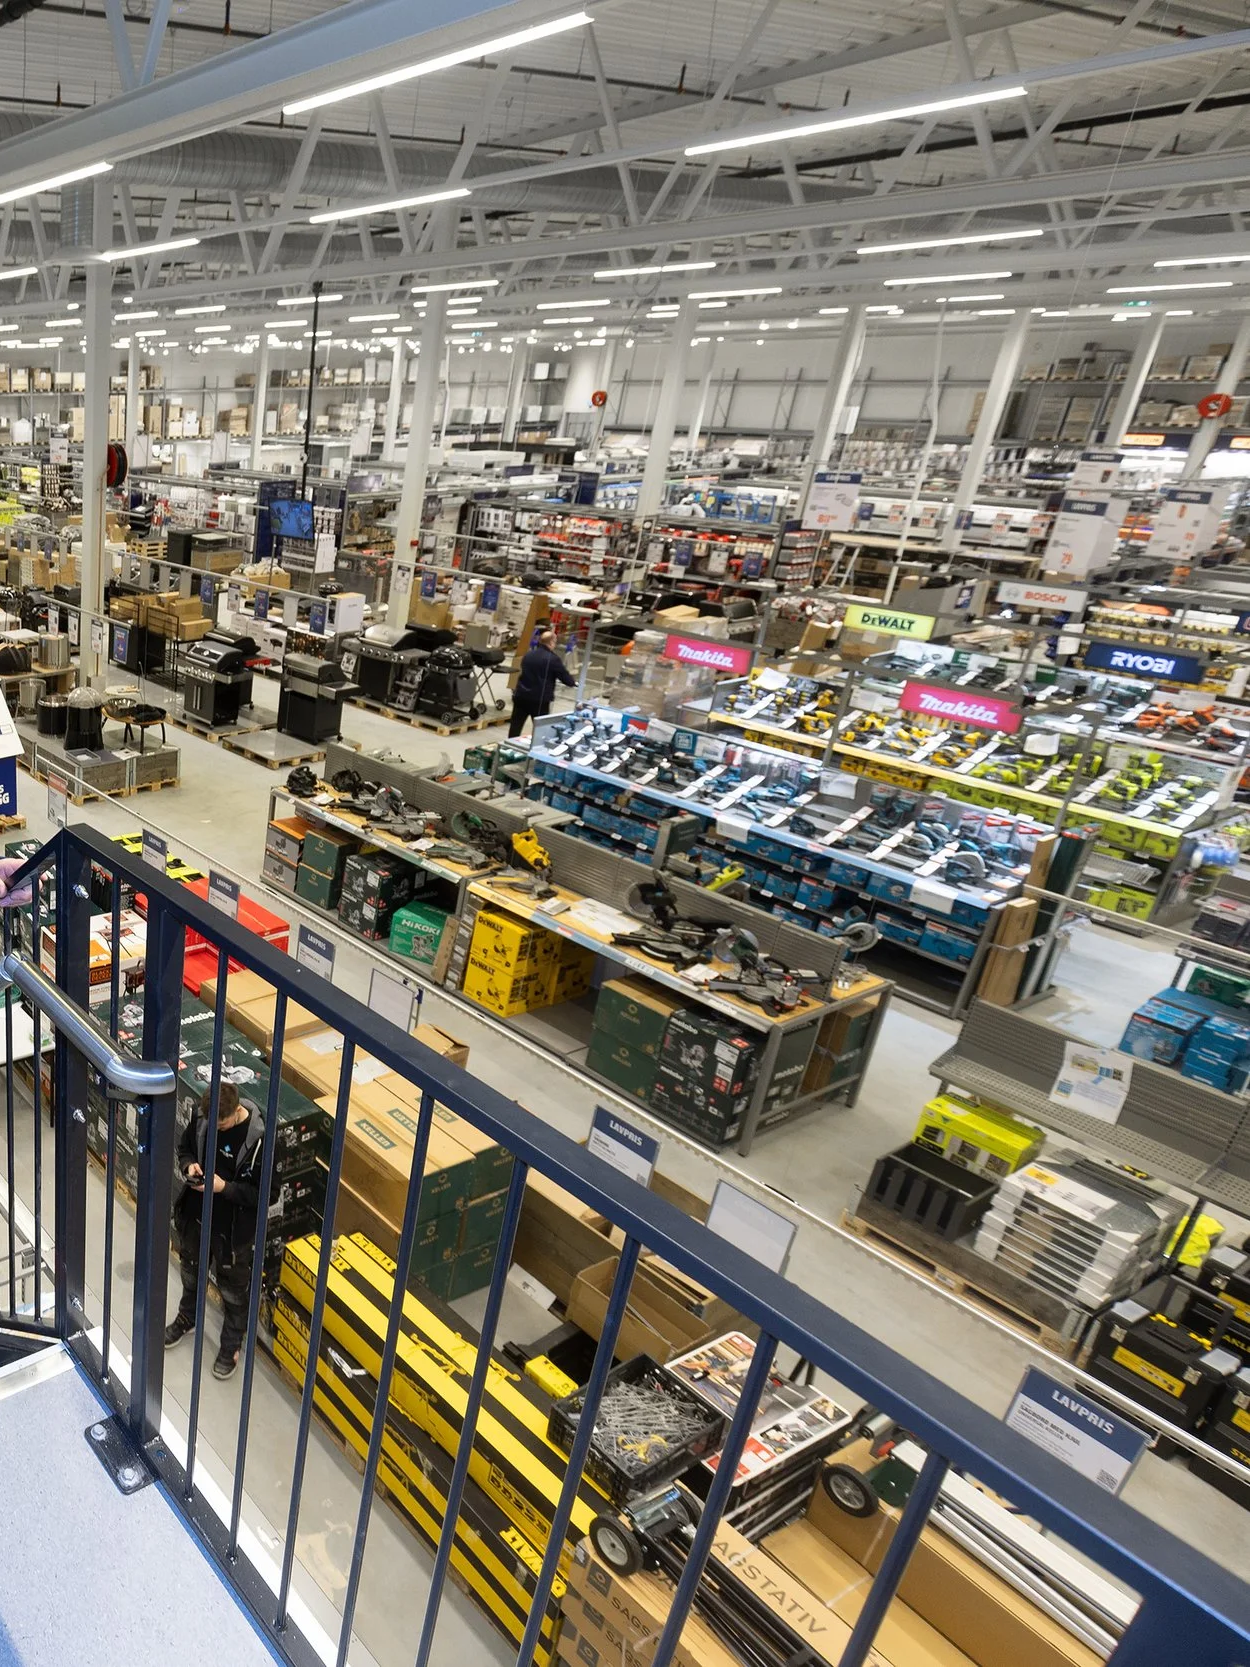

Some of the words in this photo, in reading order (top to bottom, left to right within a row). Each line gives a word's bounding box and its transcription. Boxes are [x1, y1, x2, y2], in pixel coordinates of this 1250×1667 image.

[1024, 590, 1067, 604] BOSCH
[1110, 651, 1176, 675] RYOBI
[307, 934, 326, 950] LAVPRIS
[610, 1120, 643, 1146] LAVPRIS
[1052, 1390, 1114, 1434] LAVPRIS
[714, 1538, 827, 1635] AGSTATIV
